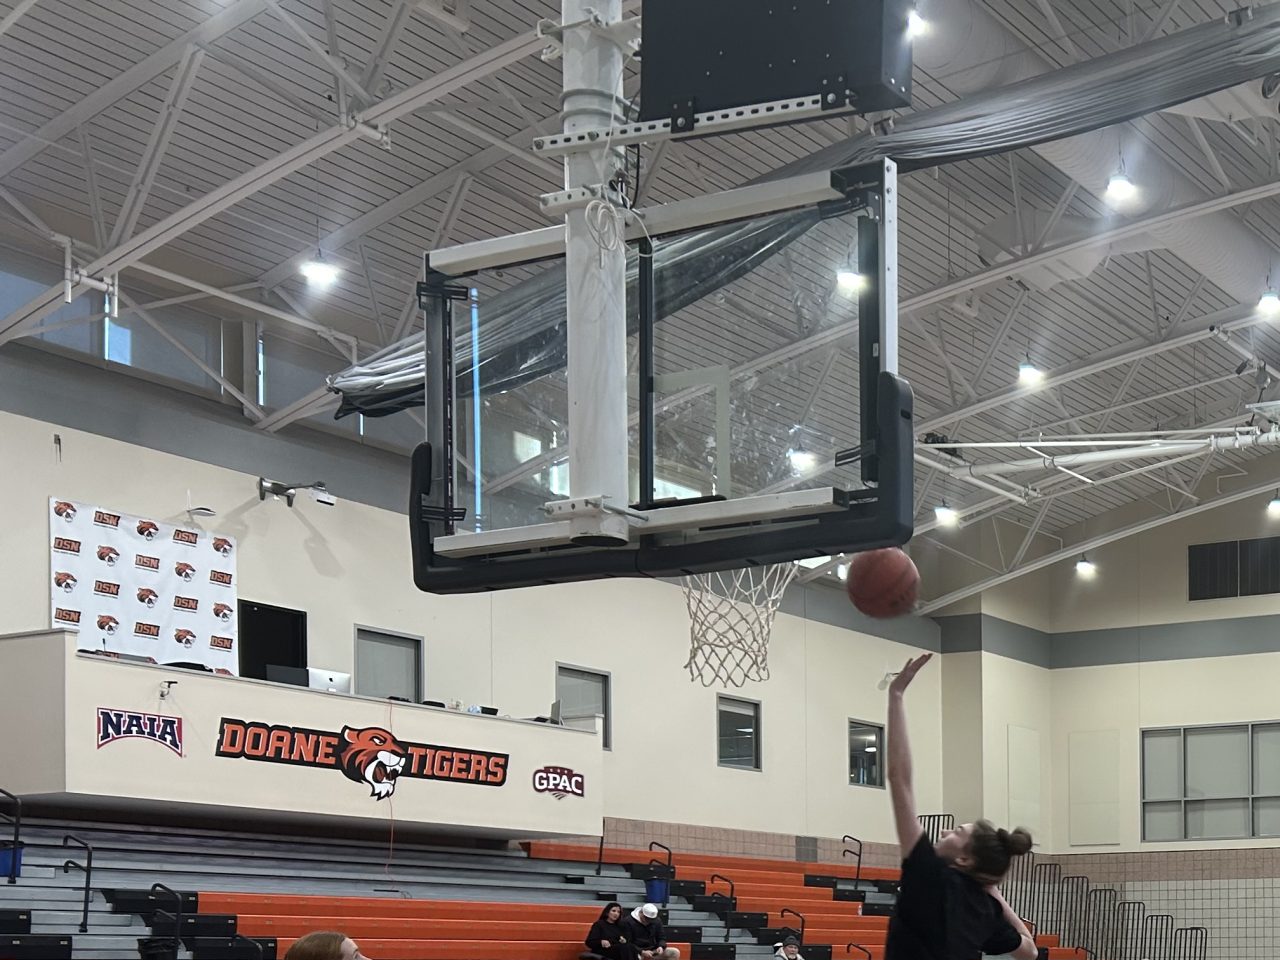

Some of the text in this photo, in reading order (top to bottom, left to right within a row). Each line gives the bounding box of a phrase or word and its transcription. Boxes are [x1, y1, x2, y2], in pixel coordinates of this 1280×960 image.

[95, 511, 119, 527] DSN
[175, 530, 198, 544] DSN
[54, 538, 80, 553] DSN
[135, 555, 160, 569] DSN
[210, 571, 232, 585] DSN
[95, 581, 120, 596] DSN
[174, 596, 198, 610] DSN
[55, 608, 81, 623] DSN
[135, 622, 160, 637] DSN
[210, 636, 233, 650] DSN
[98, 709, 181, 753] NAIA
[220, 723, 505, 783] DOANE TIGERS
[534, 772, 583, 794] GPAC
